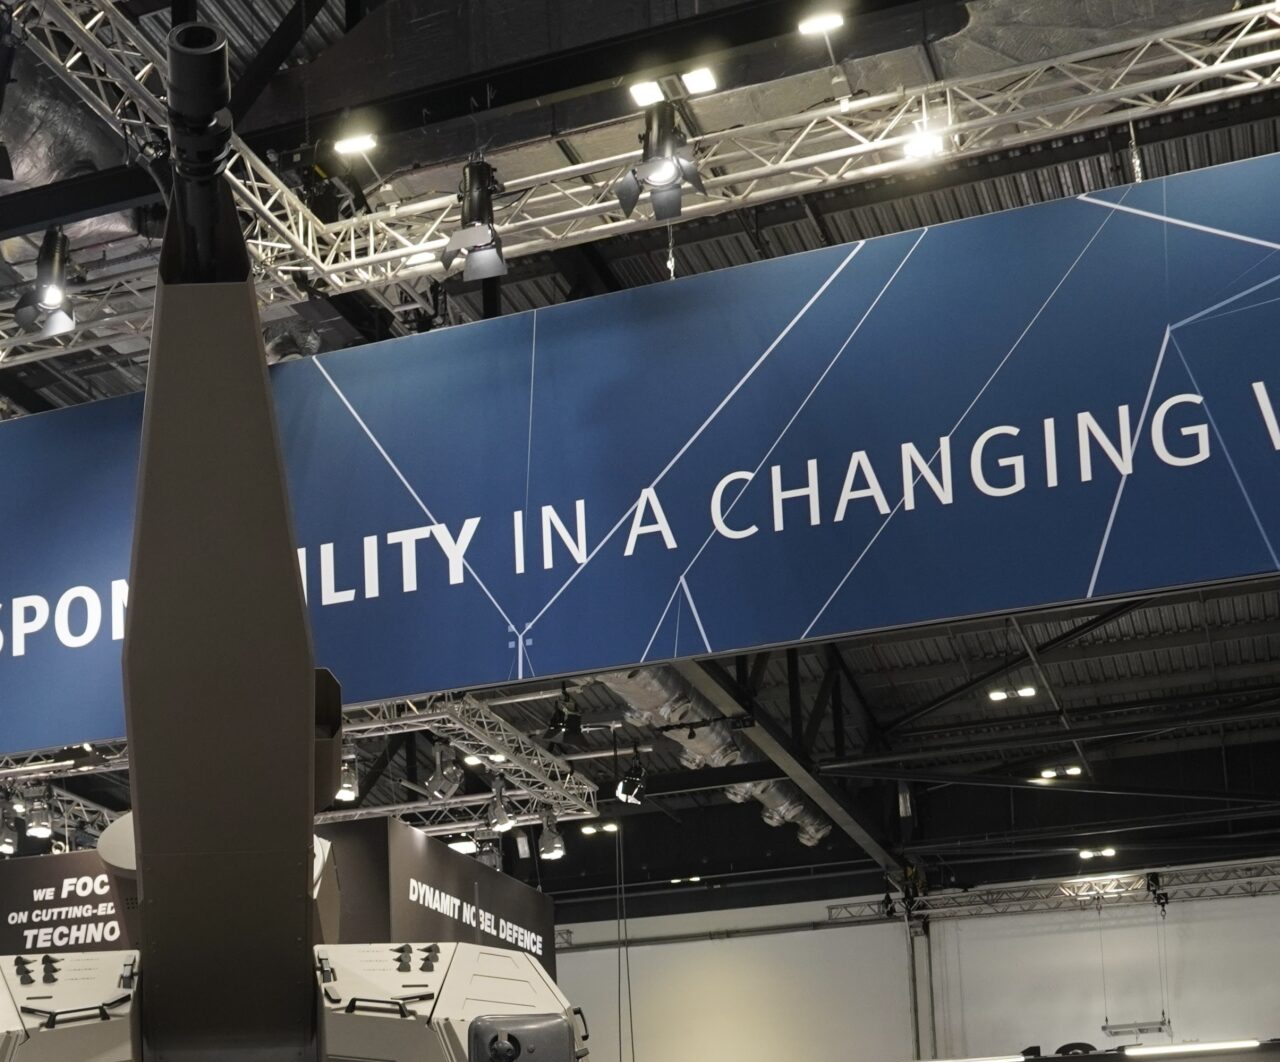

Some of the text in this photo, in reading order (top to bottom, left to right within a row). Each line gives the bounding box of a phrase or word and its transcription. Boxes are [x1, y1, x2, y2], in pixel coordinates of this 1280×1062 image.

[513, 499, 587, 574] IN
[623, 486, 677, 557] A
[710, 393, 1211, 539] CHANGING
[33, 873, 110, 901] WE FOC
[7, 902, 116, 925] ON CUTTING-ED
[409, 878, 460, 919] DYNAMIT
[498, 918, 543, 956] DEFENCE
[23, 920, 121, 949] TECHNO
